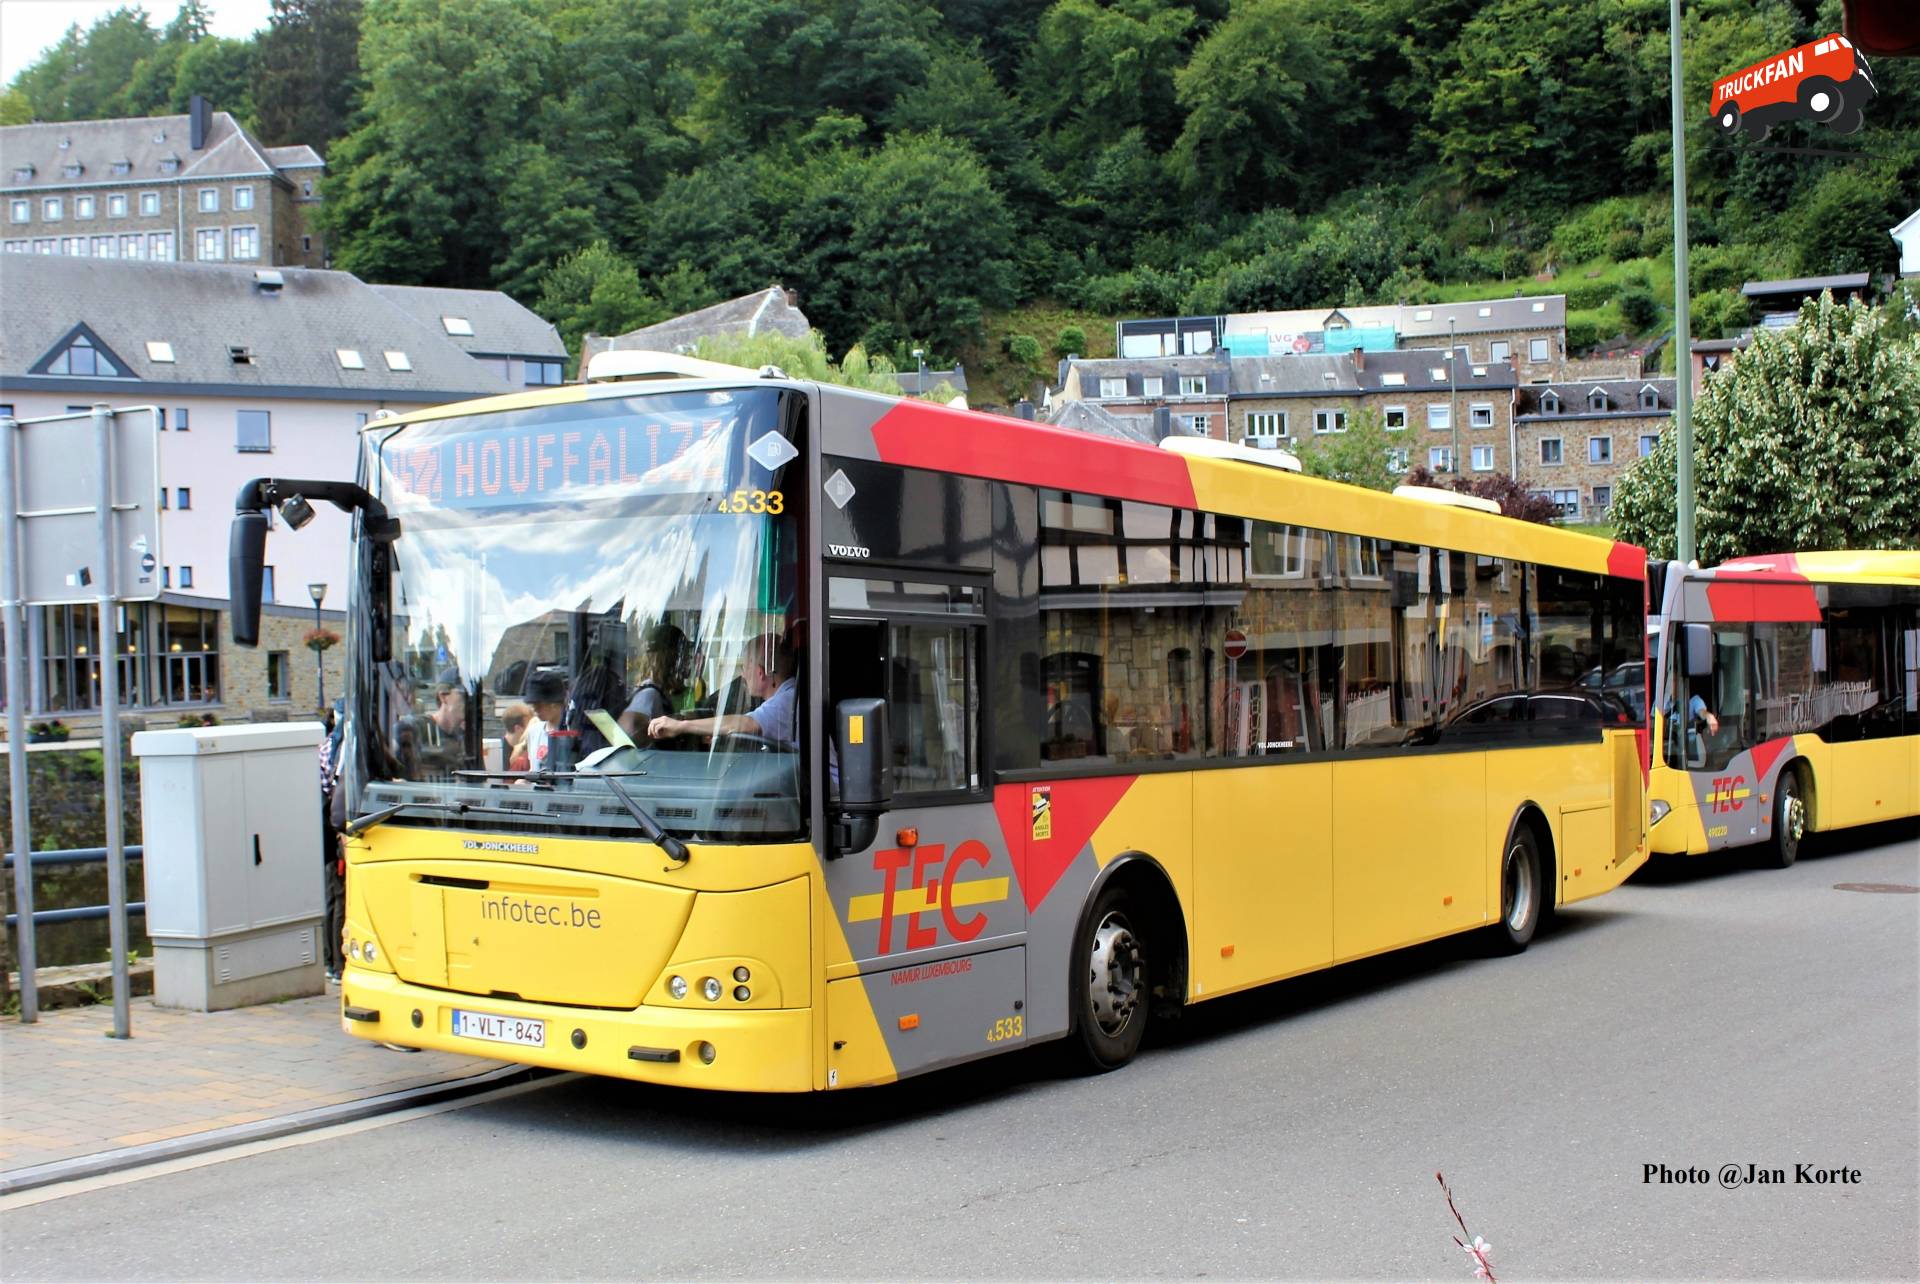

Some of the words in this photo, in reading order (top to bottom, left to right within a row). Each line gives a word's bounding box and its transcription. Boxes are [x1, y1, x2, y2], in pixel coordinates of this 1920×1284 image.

[455, 419, 721, 497] HOUFFALIZE
[718, 490, 784, 515] 4.533
[828, 543, 871, 558] VOLVO
[1712, 775, 1745, 815] TEC
[463, 839, 478, 849] VDL
[480, 840, 539, 854] JONCKHEERE
[873, 839, 992, 956] TEC
[481, 895, 601, 929] infotec.be
[891, 967, 921, 986] NAMUR
[921, 958, 973, 980] LUXEMBOURG
[462, 1015, 543, 1042] 1-VLT-843
[986, 1015, 1023, 1042] 4.533
